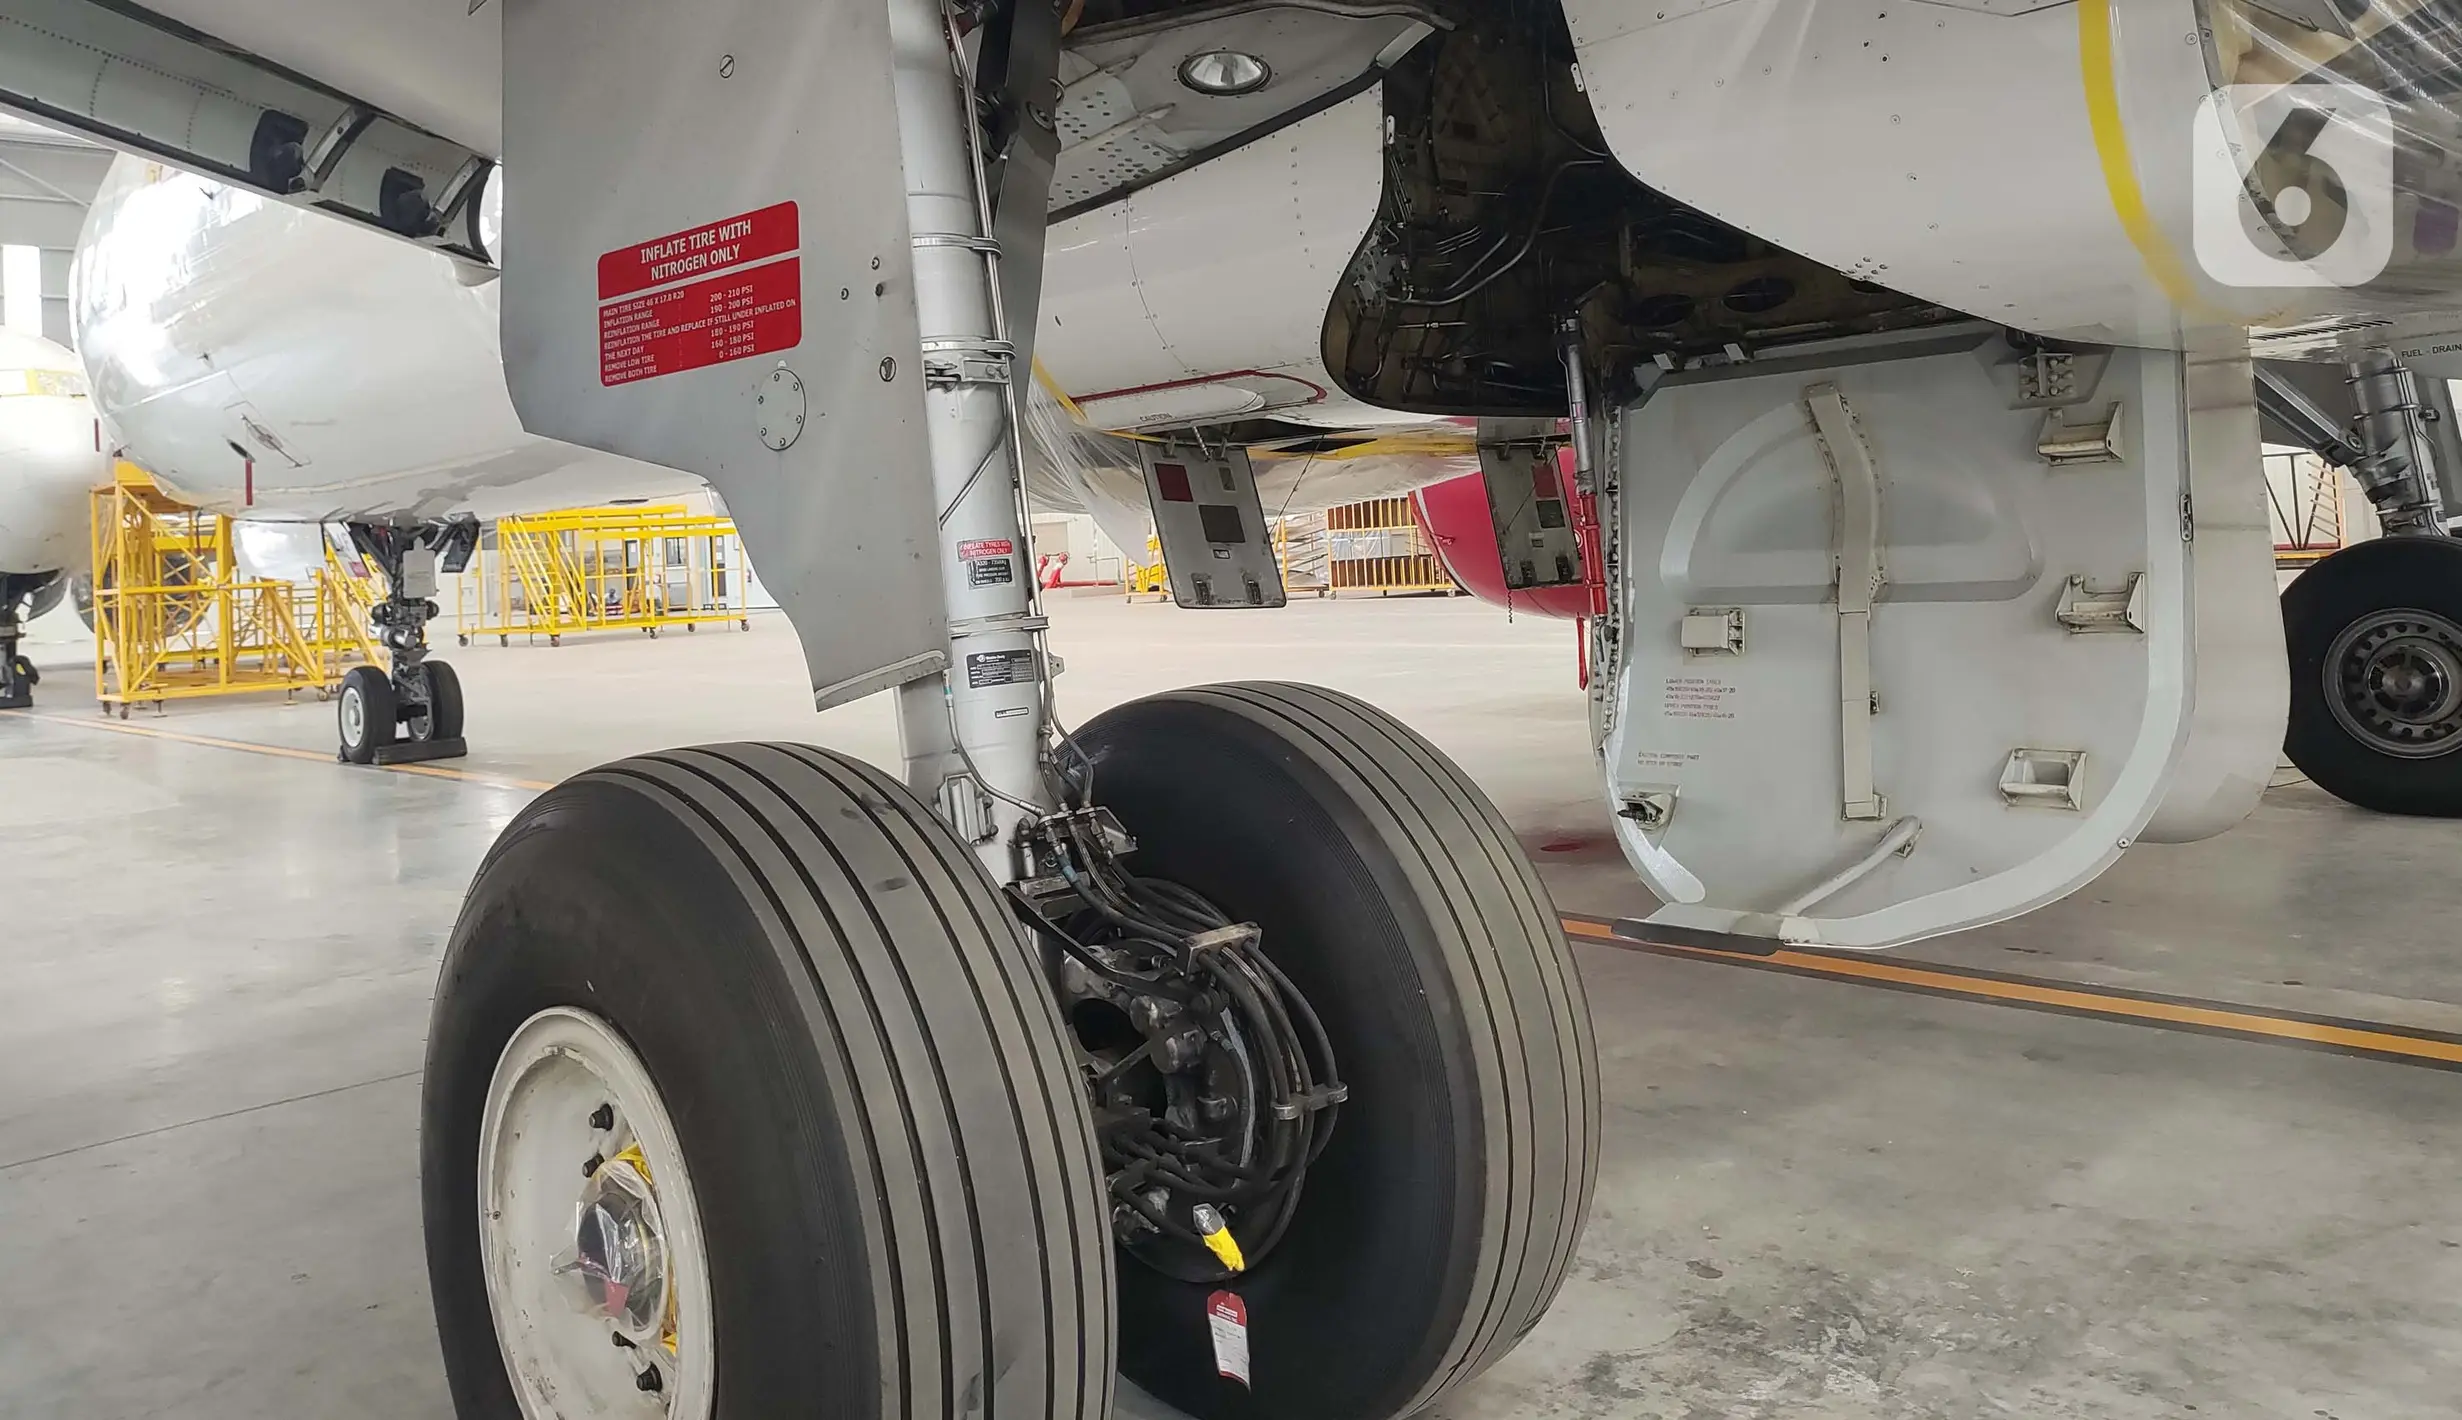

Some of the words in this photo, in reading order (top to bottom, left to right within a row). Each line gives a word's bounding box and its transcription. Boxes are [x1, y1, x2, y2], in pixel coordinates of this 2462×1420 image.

[641, 238, 686, 264] INFLATE
[689, 229, 715, 250] TIRE
[718, 219, 751, 242] WITH
[651, 252, 707, 281] NITROGEN
[710, 243, 740, 265] ONLY
[603, 308, 618, 318] MAIN
[620, 303, 631, 313] TIRE
[632, 300, 645, 310] SIZE
[654, 297, 659, 305] X
[604, 314, 633, 328] INFLATION
[634, 309, 653, 320] RANGE
[710, 292, 722, 302] 200
[728, 287, 740, 298] 210
[741, 284, 753, 294] PSI
[604, 324, 640, 339] REINFLATION
[641, 319, 660, 330] RANGE
[710, 304, 722, 314] 190
[728, 299, 740, 310] 200
[741, 296, 753, 306] PSI
[604, 335, 640, 350] REINFLATION
[641, 332, 652, 341] THE
[653, 328, 666, 338] TIRE
[667, 326, 680, 335] AND
[680, 319, 706, 332] REPLACE
[707, 317, 714, 326] IF
[714, 313, 731, 325] STILL
[732, 309, 754, 320] UNDER
[754, 301, 785, 316] INFLATED
[785, 298, 796, 308] ON
[605, 352, 616, 361] THE
[617, 348, 631, 358] NEXT
[632, 345, 645, 354] DAY
[711, 327, 723, 338] 180
[729, 323, 741, 333] 190
[742, 320, 754, 330] PSI
[605, 360, 627, 372] REMOVE
[627, 358, 640, 367] LOW
[641, 354, 655, 363] TIRE
[711, 339, 723, 349] 160
[729, 335, 741, 345] 180
[742, 331, 754, 341] PSI
[2401, 349, 2423, 358] FUEL
[2432, 343, 2462, 354] DRAIN
[605, 371, 627, 382] REMOVE
[627, 368, 643, 378] BOTH
[644, 365, 657, 374] TIRE
[719, 350, 724, 359] 0
[729, 346, 741, 357] 160
[742, 344, 755, 353] PSI
